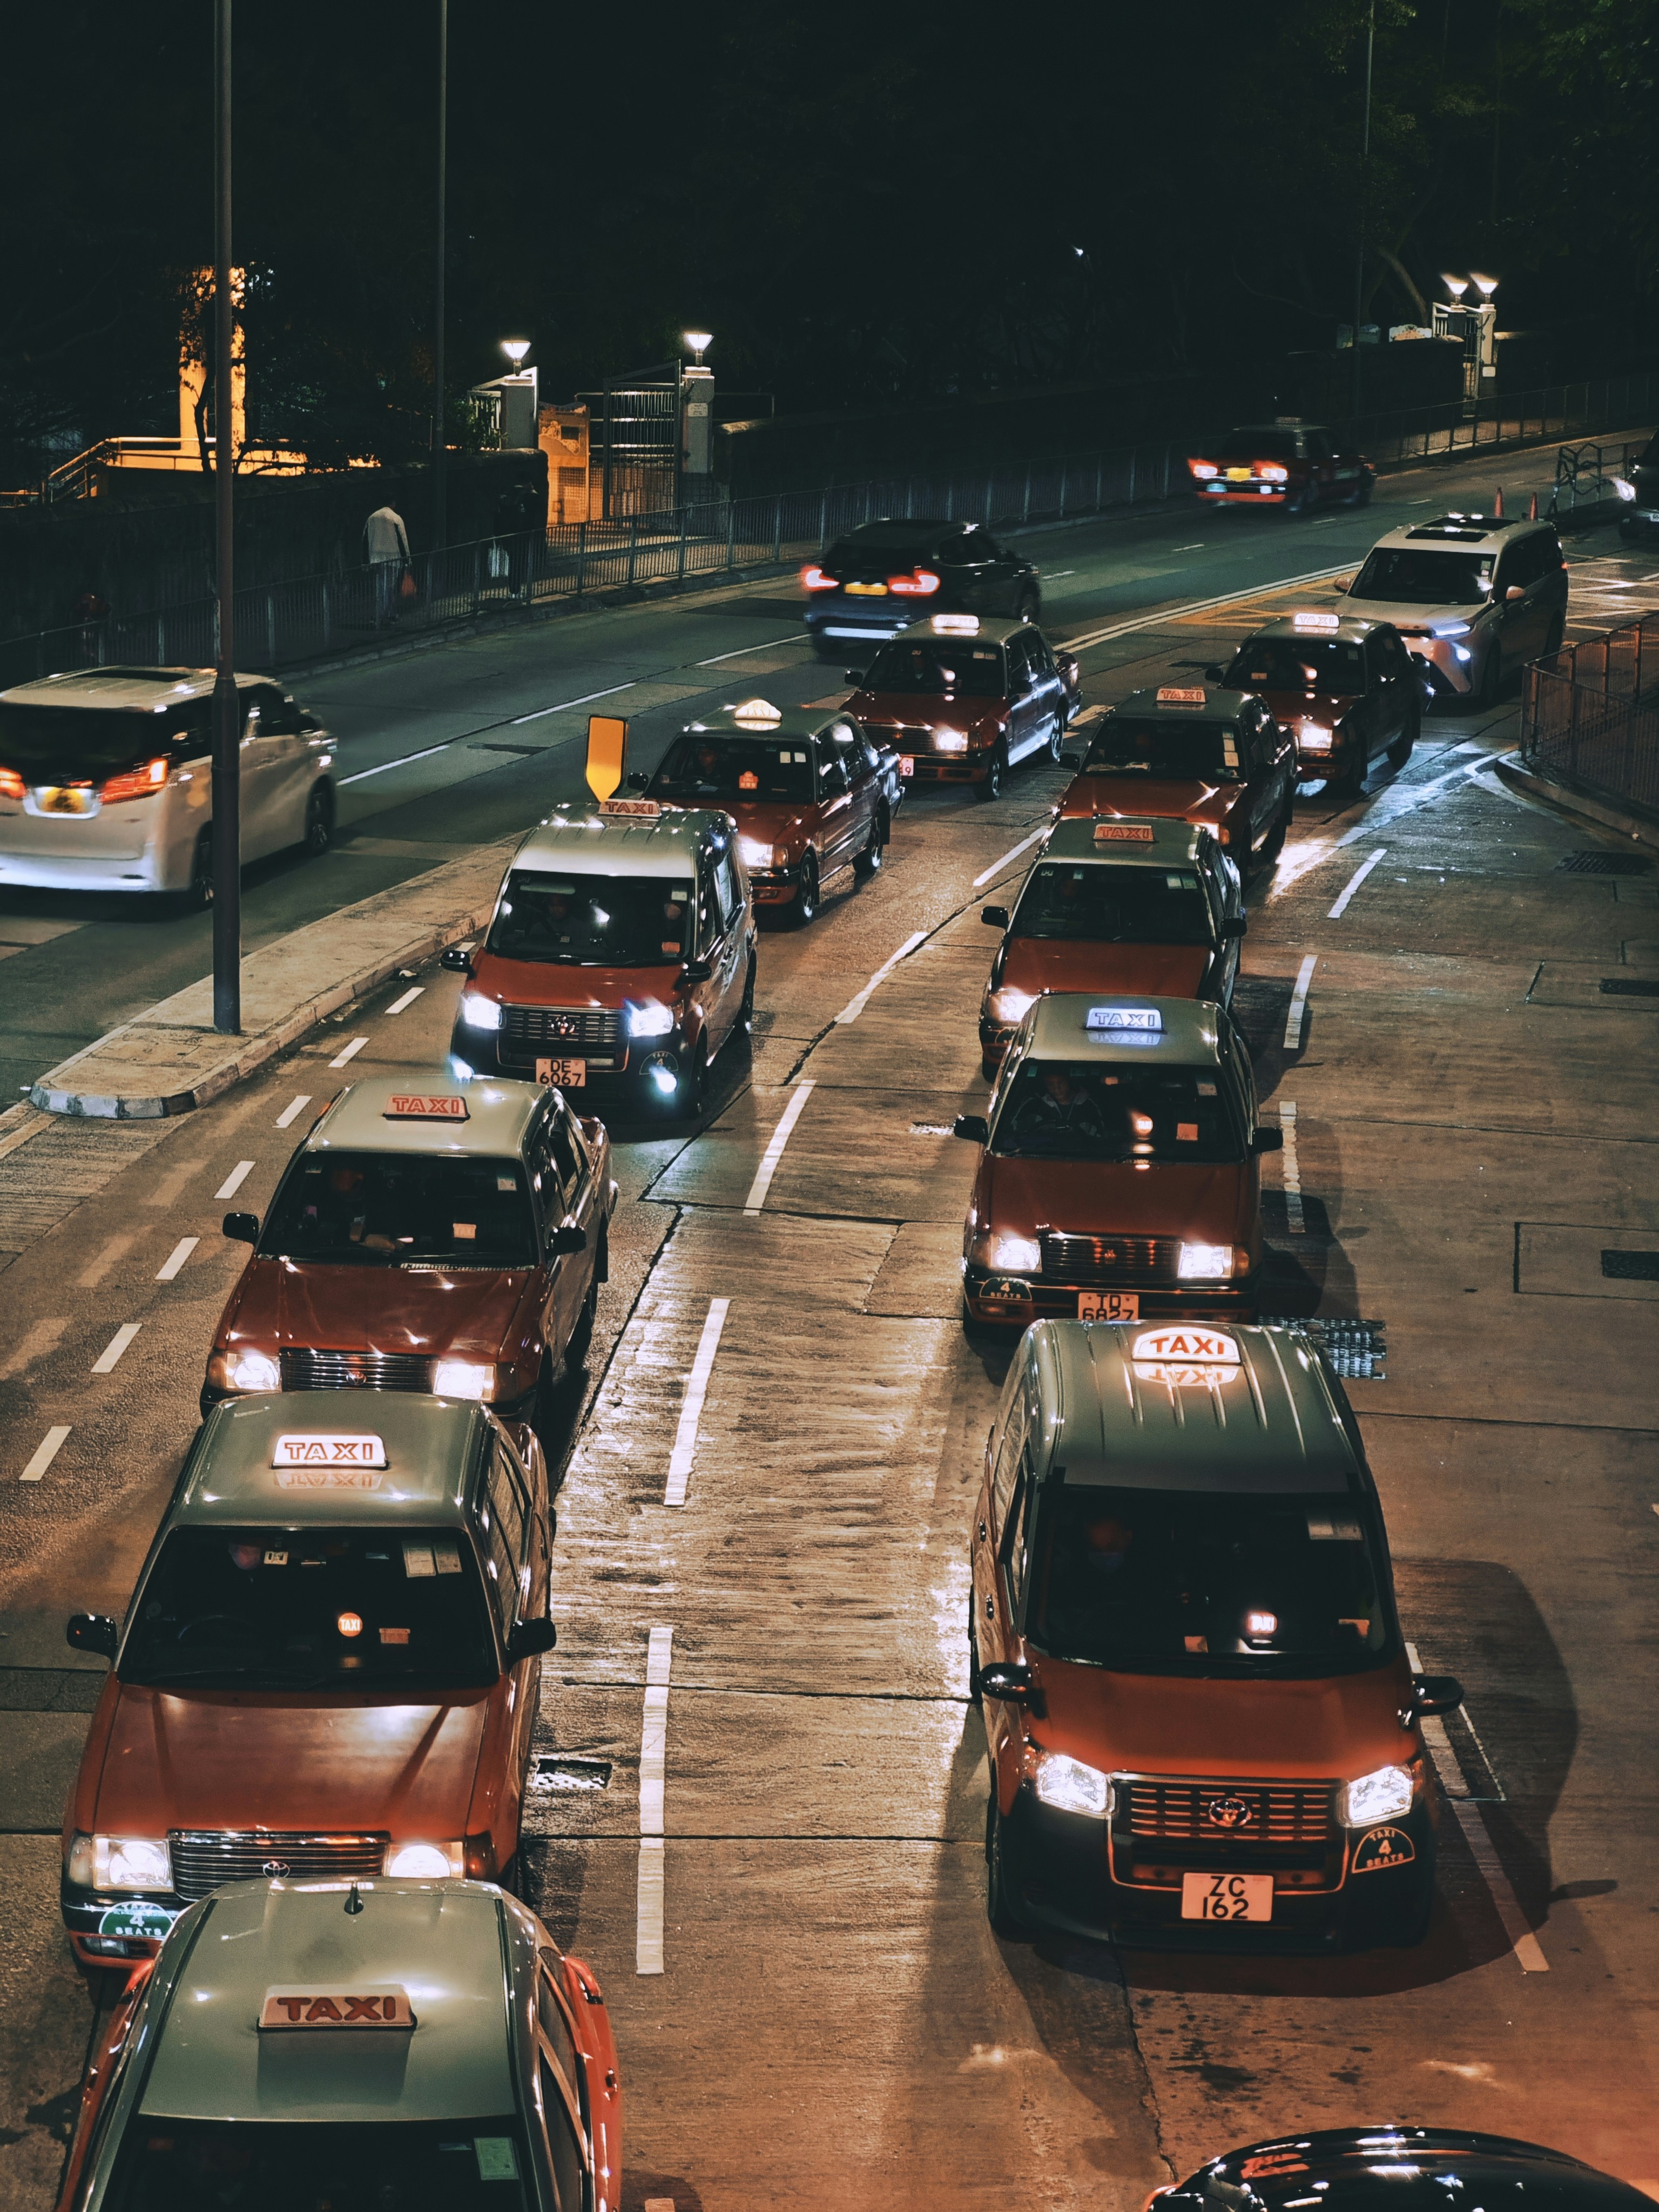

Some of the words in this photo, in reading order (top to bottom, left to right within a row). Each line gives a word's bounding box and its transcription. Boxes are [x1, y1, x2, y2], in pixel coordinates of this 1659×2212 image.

[1298, 615, 1334, 625] TAXI
[1161, 690, 1202, 700] TAXI
[745, 708, 772, 717] TAXI
[605, 801, 654, 814] TAXI
[1099, 827, 1149, 839] TAXI
[1095, 1013, 1155, 1027] TAXI
[551, 1060, 571, 1073] DE
[539, 1071, 582, 1086] 6067
[392, 1097, 460, 1114] TAXI
[1000, 1282, 1010, 1292] 4
[1096, 1293, 1121, 1309] TD
[1083, 1307, 1134, 1320] 6827
[1150, 1336, 1225, 1355] TAXI
[285, 1442, 373, 1460] TAXI
[341, 1618, 361, 1631] TAXI
[1370, 1829, 1396, 1842] TAXI
[1378, 1839, 1392, 1854] 4
[1366, 1852, 1404, 1868] SEATS
[1209, 1876, 1245, 1897] ZC
[1203, 1897, 1249, 1919] 162
[130, 1912, 145, 1927] 4
[115, 1927, 163, 1936] SEATS
[276, 1996, 396, 2021] TAXI
